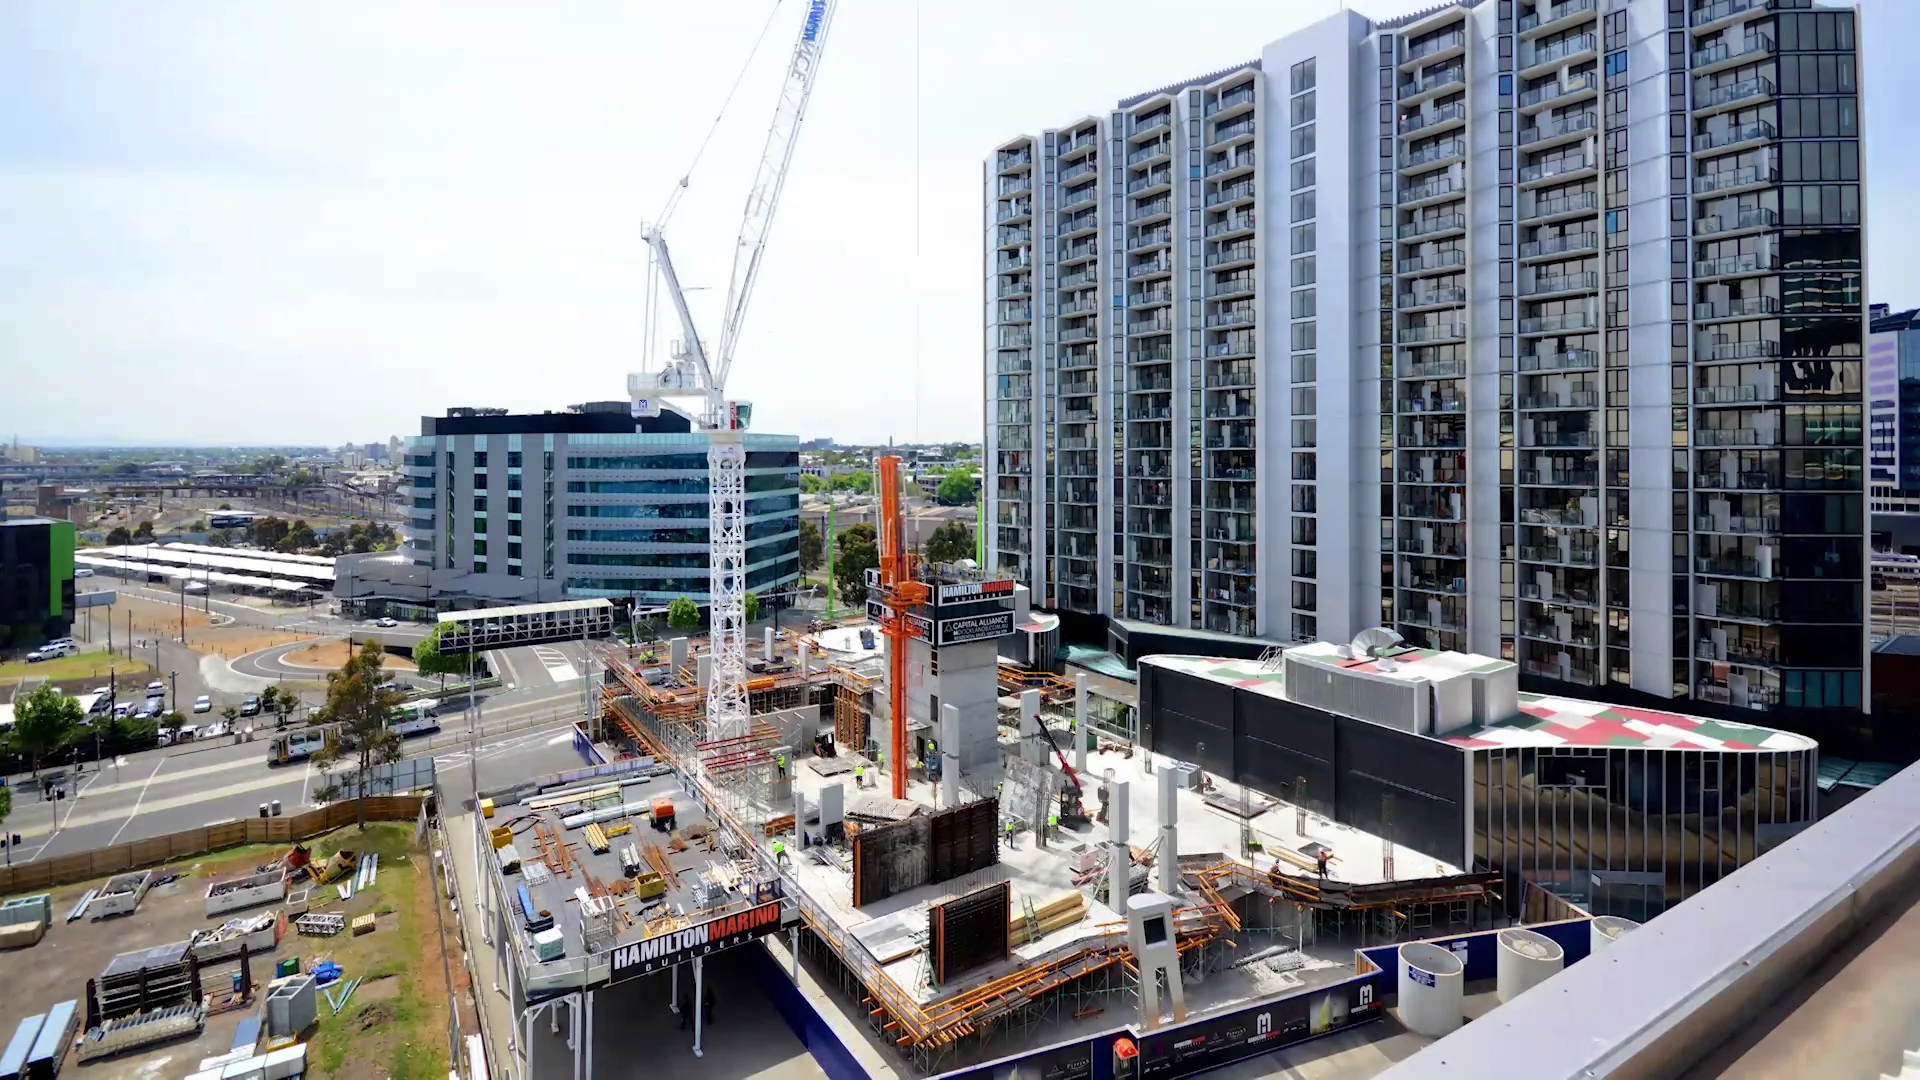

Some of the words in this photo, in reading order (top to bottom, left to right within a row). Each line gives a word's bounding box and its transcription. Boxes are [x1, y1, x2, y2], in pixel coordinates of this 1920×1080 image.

[953, 621, 978, 630] CAPITAL
[979, 615, 1009, 626] ALLIANCE
[645, 932, 753, 972] BUILDERS
